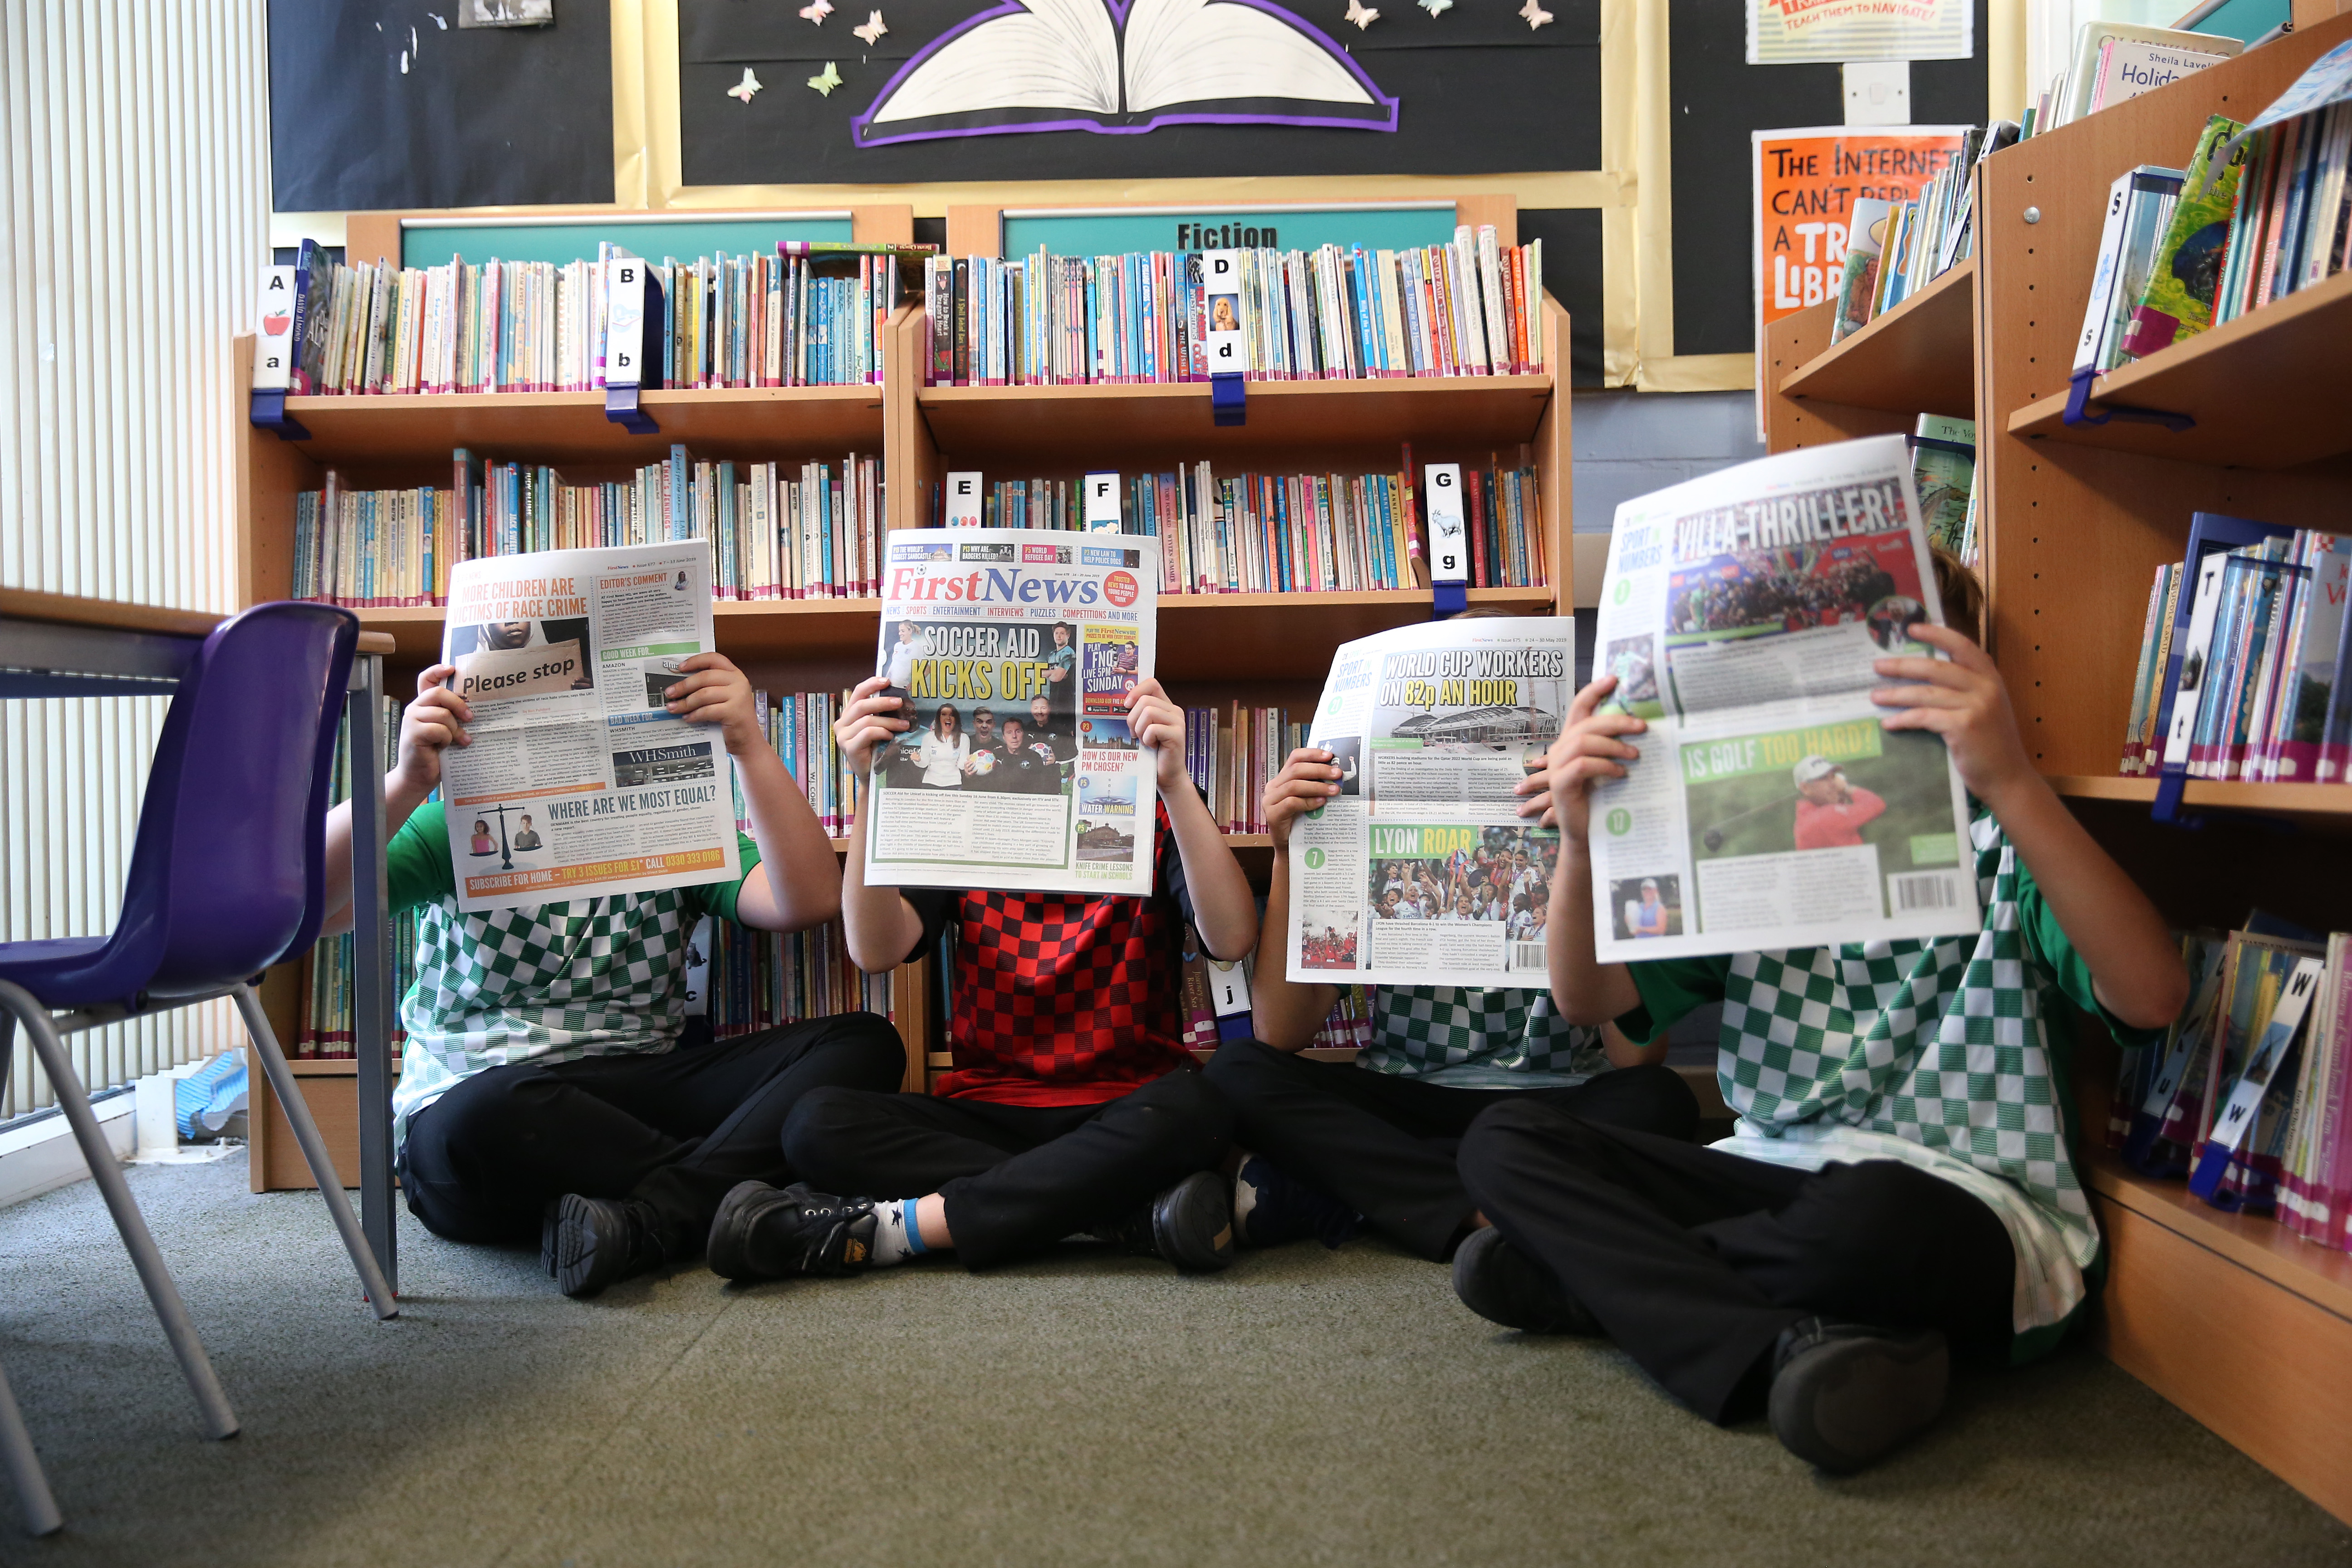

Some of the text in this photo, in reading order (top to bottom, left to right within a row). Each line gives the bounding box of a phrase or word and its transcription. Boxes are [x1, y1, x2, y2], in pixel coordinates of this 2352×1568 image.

[1785, 14, 1820, 30] TEACH
[1823, 6, 1854, 19] THEM
[1856, 5, 1870, 13] TO
[1871, 3, 1935, 22] NAVIGATE!
[2149, 53, 2179, 65] Sheila
[1769, 149, 1818, 178] THE
[1772, 183, 1851, 215] CAN'T
[2112, 191, 2122, 216] S
[1177, 221, 1278, 249] Fiction
[1774, 225, 1791, 251] A
[621, 269, 634, 283] B
[1215, 260, 1229, 274] D
[270, 275, 284, 290] A
[1220, 343, 1231, 357] d
[267, 357, 279, 368] a
[619, 353, 631, 367] b
[958, 480, 971, 495] E
[1436, 473, 1451, 487] G
[1097, 483, 1109, 497] F
[1678, 484, 1897, 561] VILLA THRILLER!
[1443, 554, 1455, 570] g
[462, 578, 575, 603] MORE CHILDREN ARE
[600, 573, 667, 589] EDITOR'S COMMENT
[888, 566, 1098, 604] FirstNews
[2204, 572, 2215, 596] T
[454, 598, 588, 624] VICTIMS OF RACE CRIME
[886, 606, 1137, 621] NEWS SPORTS ENTERTAINMENT INTERVIEWS PUZZLES COMPETITIONS AND MORE
[923, 626, 1040, 658] SOCCER AID
[1088, 643, 1101, 652] PLAY
[603, 650, 619, 660] GOOD
[620, 649, 637, 658] WEEK
[1083, 667, 1111, 679] LIVE 5PM
[1338, 659, 1364, 677] SPORT
[1386, 650, 1563, 680] WORLD CUP WORKERS
[463, 658, 574, 694] Please stop
[911, 659, 1050, 701] KICKS OFF
[1087, 676, 1123, 692] SUNDAY
[1333, 672, 1372, 693] NUMBERS
[1379, 679, 1518, 711] ON 82p AN HOUR
[610, 716, 623, 725] BAD
[624, 714, 640, 723] WEEK
[2177, 714, 2184, 739] t
[629, 745, 696, 764] WHSmith
[1082, 751, 1138, 761] HOW IS OUR NEW
[1686, 721, 1872, 779] IS GOLF TOO HARD?
[1082, 762, 1124, 772] PM CHOSEN?
[548, 785, 716, 820] WHERE ARE WE MOST EQUAL?
[1082, 804, 1134, 814] WATER WARNING
[1375, 828, 1471, 854] LYON ROAR
[1312, 851, 1318, 866] 7
[470, 875, 512, 891] SUBSCRIBE
[514, 873, 529, 886] FOR
[530, 870, 553, 884] HOME
[562, 867, 576, 879] TRY
[578, 867, 584, 877] 3
[586, 863, 612, 877] ISSUES
[614, 862, 629, 873] FOR
[646, 857, 665, 869] CALL
[666, 853, 685, 867] 0330
[686, 852, 701, 863] 333
[702, 850, 720, 862] 0186
[1108, 872, 1132, 880] SCHOOLS
[2293, 971, 2313, 997] W
[1226, 985, 1234, 1004] j
